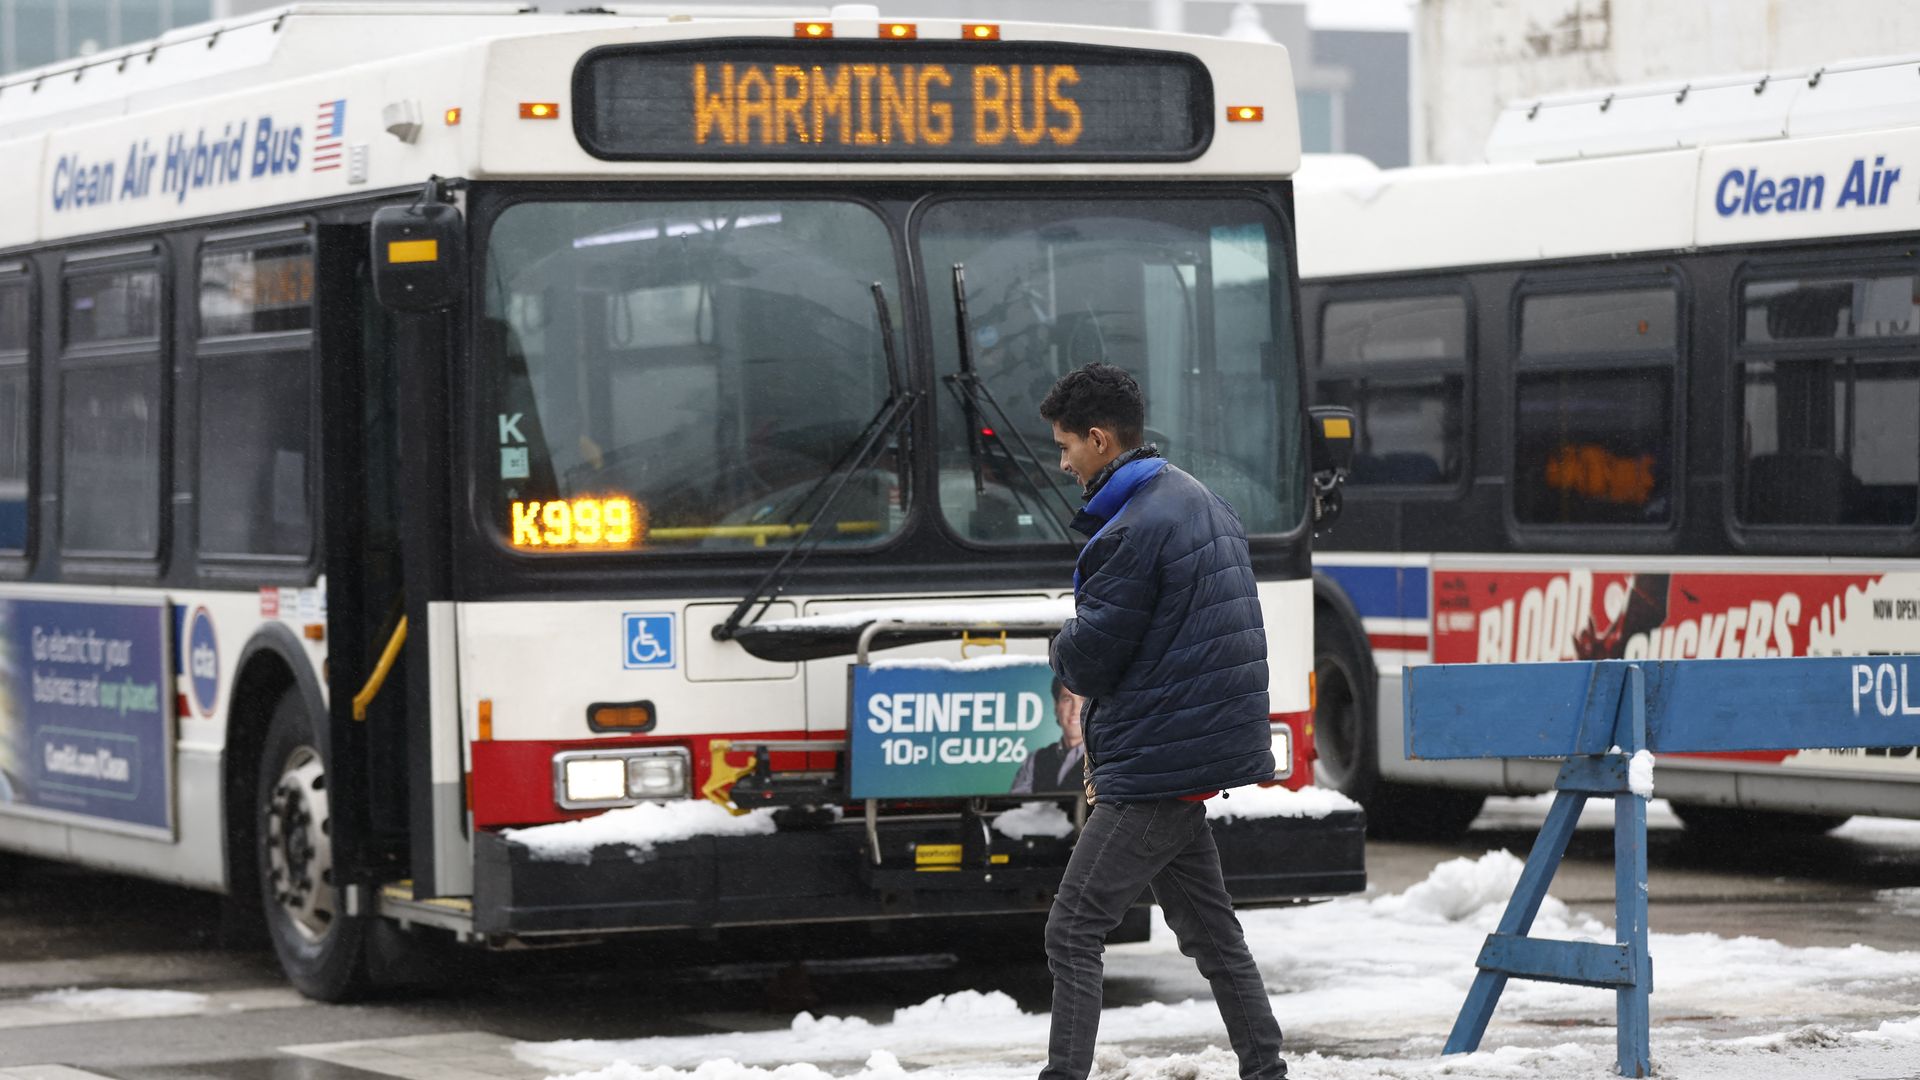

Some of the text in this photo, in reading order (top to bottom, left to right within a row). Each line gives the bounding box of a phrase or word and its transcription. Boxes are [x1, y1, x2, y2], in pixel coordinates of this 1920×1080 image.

[692, 63, 1083, 145] WARMING BUS
[52, 116, 303, 212] Clean Air Hybrid Bus
[1715, 156, 1901, 217] Clean Air
[498, 413, 527, 444] K
[512, 498, 633, 545] K999
[1873, 599, 1893, 620] NOW
[867, 692, 1043, 733] SEINFELD
[1852, 663, 1920, 717] POL
